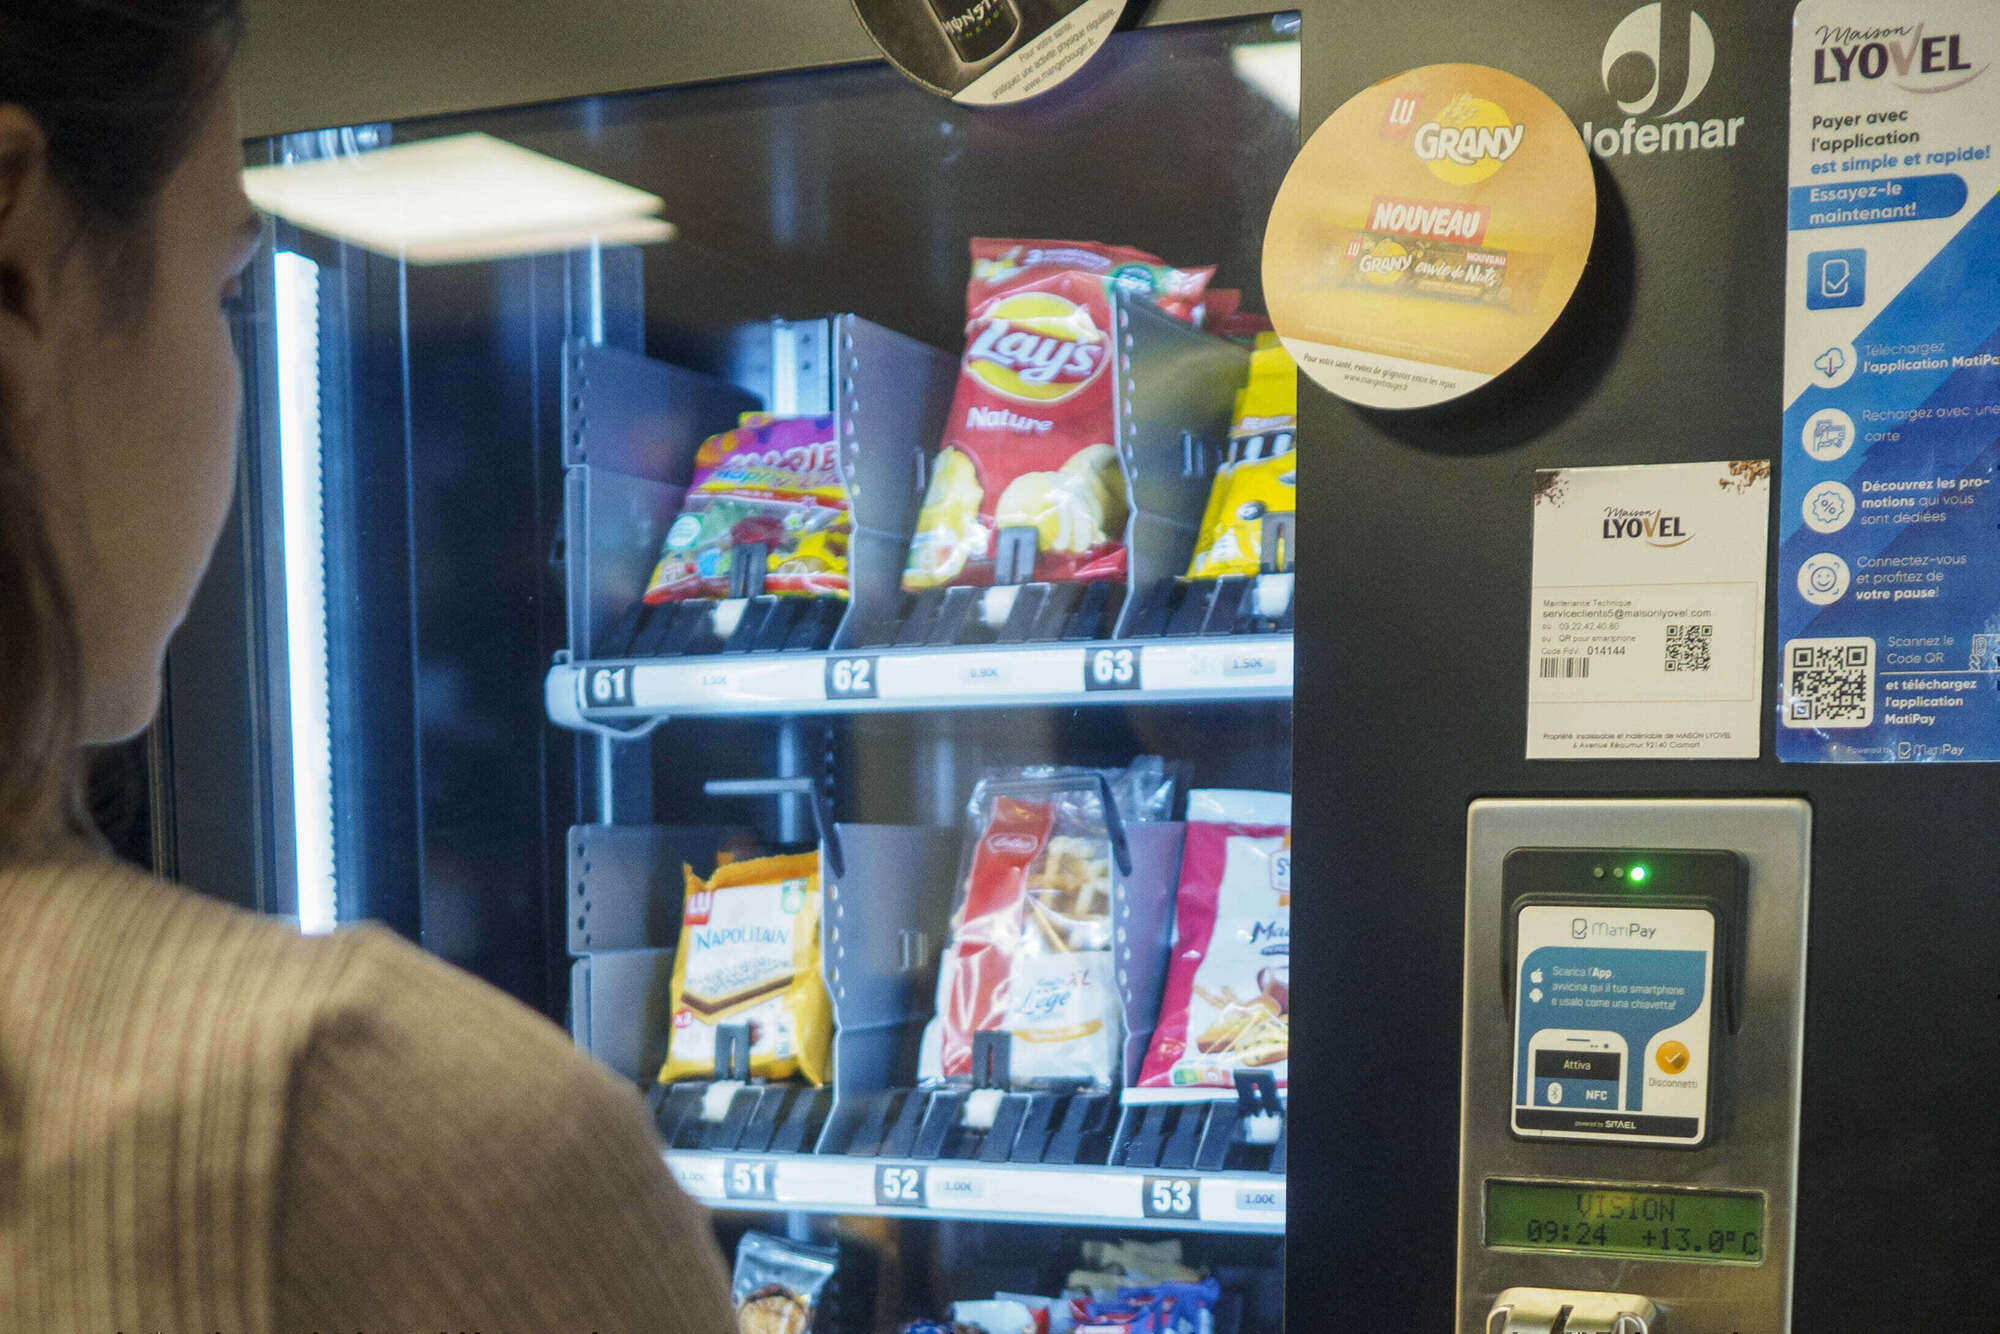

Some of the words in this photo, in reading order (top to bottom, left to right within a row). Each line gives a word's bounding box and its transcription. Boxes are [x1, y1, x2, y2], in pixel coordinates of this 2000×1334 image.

[1816, 24, 1914, 46] Maison
[1814, 23, 1972, 85] LYOVEL
[1389, 97, 1416, 125] LU
[1812, 114, 1861, 131] Payer
[1866, 110, 1909, 125] avec
[1414, 122, 1526, 166] GRANY
[1811, 130, 1920, 153] l'application
[1811, 160, 1837, 175] est
[1841, 154, 1899, 173] simple
[1903, 153, 1922, 166] et
[1926, 144, 1992, 166] rapide!
[1810, 181, 1903, 203] Essayez-le
[1371, 202, 1482, 239] NOUVEAU
[1809, 201, 1918, 225] maintenant!
[1359, 254, 1414, 274] GRANY
[1865, 342, 1945, 357] Téléchargez
[1863, 358, 1949, 375] l'application
[966, 405, 1053, 435] Nature
[1862, 409, 1934, 423] Rechargez
[1936, 406, 1971, 418] avec
[1975, 404, 2000, 416] une
[1864, 431, 1901, 442] carte
[1862, 479, 1934, 493] Découvrez
[1937, 477, 1956, 489] les
[1959, 477, 1992, 491] pro-
[1862, 495, 1916, 509] motions
[1919, 496, 1941, 509] qui
[1943, 494, 1975, 505] vous
[1603, 505, 1657, 520] Maison
[1861, 514, 1890, 526] sont
[1603, 507, 1687, 539] LYOVEL
[1856, 554, 1968, 569] Connectez-vous
[1856, 573, 1870, 585] et
[1873, 570, 1923, 585] profitez
[1926, 570, 1945, 582] de
[1593, 599, 1632, 607] Technique
[1856, 588, 1891, 601] votre
[1894, 586, 1940, 602] pause!
[1587, 645, 1626, 656] 014144
[1887, 635, 1941, 648] Scannez
[1943, 634, 1955, 646] le
[1093, 648, 1134, 683] 63
[1886, 653, 1922, 665] Code
[1924, 652, 1945, 664] QR
[593, 668, 627, 700] 61
[833, 659, 871, 691] 62
[1885, 680, 1899, 691] et
[1902, 679, 1978, 692] téléchargez
[1884, 696, 1965, 710] l'application
[1884, 713, 1936, 727] MatiPay
[695, 926, 791, 951] NAPOLITAIN
[1589, 984, 1603, 994] qui
[1613, 984, 1627, 993] tuo
[1630, 985, 1686, 996] smartphone
[1563, 1059, 1592, 1071] Attiva
[1648, 1076, 1699, 1089] Disconnetti
[1586, 1089, 1609, 1101] NFC
[732, 1162, 767, 1193] 51
[883, 1168, 920, 1200] 52
[1152, 1179, 1193, 1213] 53
[1244, 1193, 1276, 1205] 1.00€
[1576, 1193, 1676, 1222] VISION
[1527, 1219, 1608, 1247] 09:24
